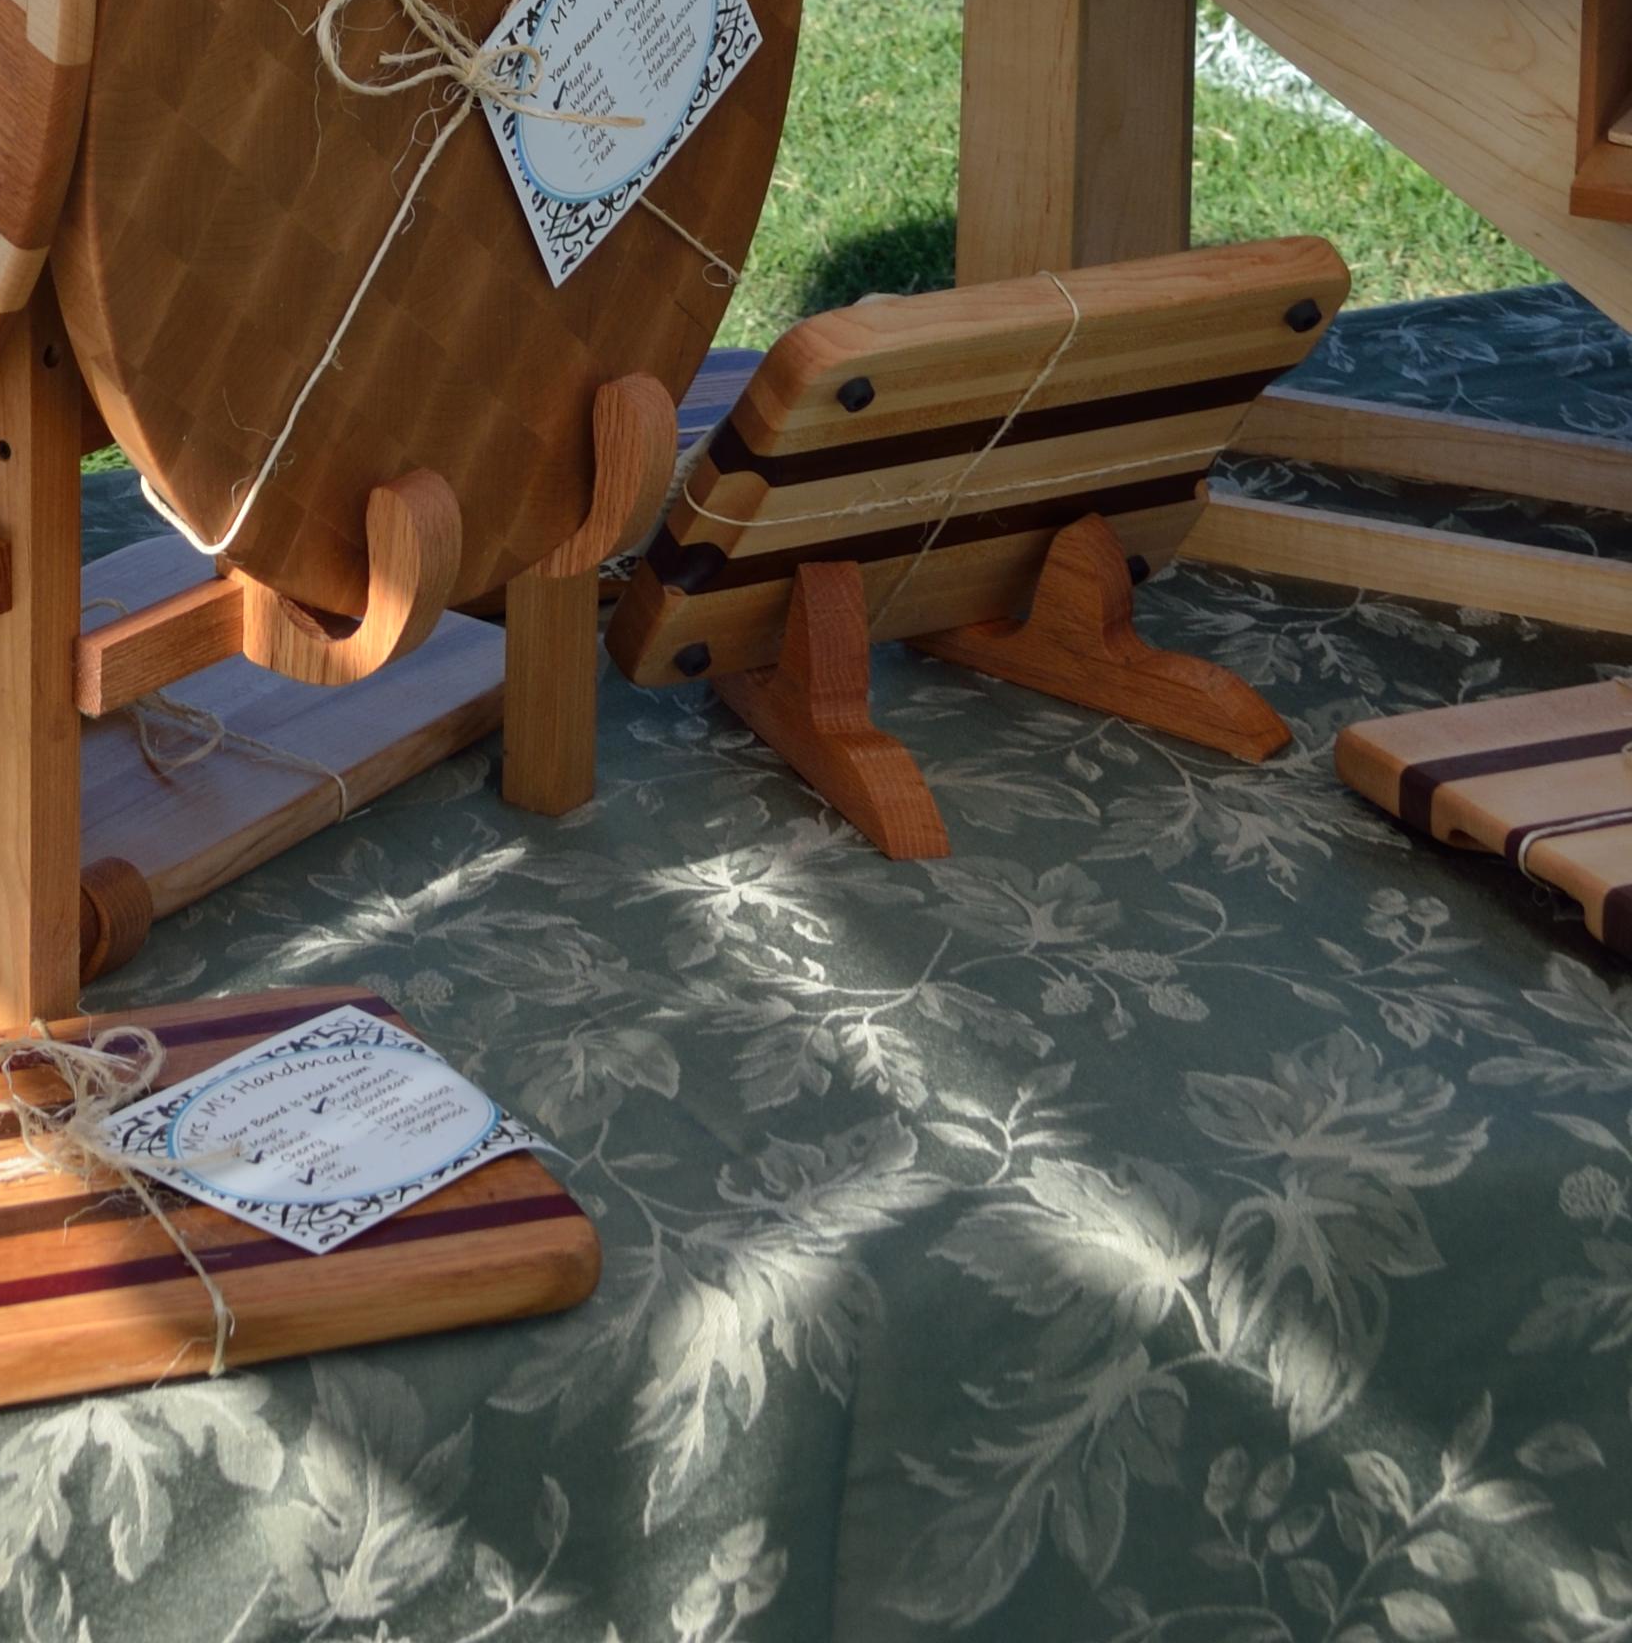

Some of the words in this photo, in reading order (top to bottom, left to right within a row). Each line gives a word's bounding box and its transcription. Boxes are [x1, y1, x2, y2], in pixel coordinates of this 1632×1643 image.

[549, 55, 572, 83] Your
[574, 20, 602, 57] Board
[605, 9, 612, 22] Is
[638, 13, 665, 50] Jatoba
[642, 31, 670, 64] Honey
[647, 24, 691, 79] Mahogany
[653, 34, 696, 91] Tigerwood
[565, 62, 592, 96] Maple
[570, 69, 604, 110] Walnut
[588, 129, 606, 153] Oak
[594, 139, 616, 166] Teak
[200, 1094, 236, 1116] M's
[232, 1050, 375, 1094] Handmade
